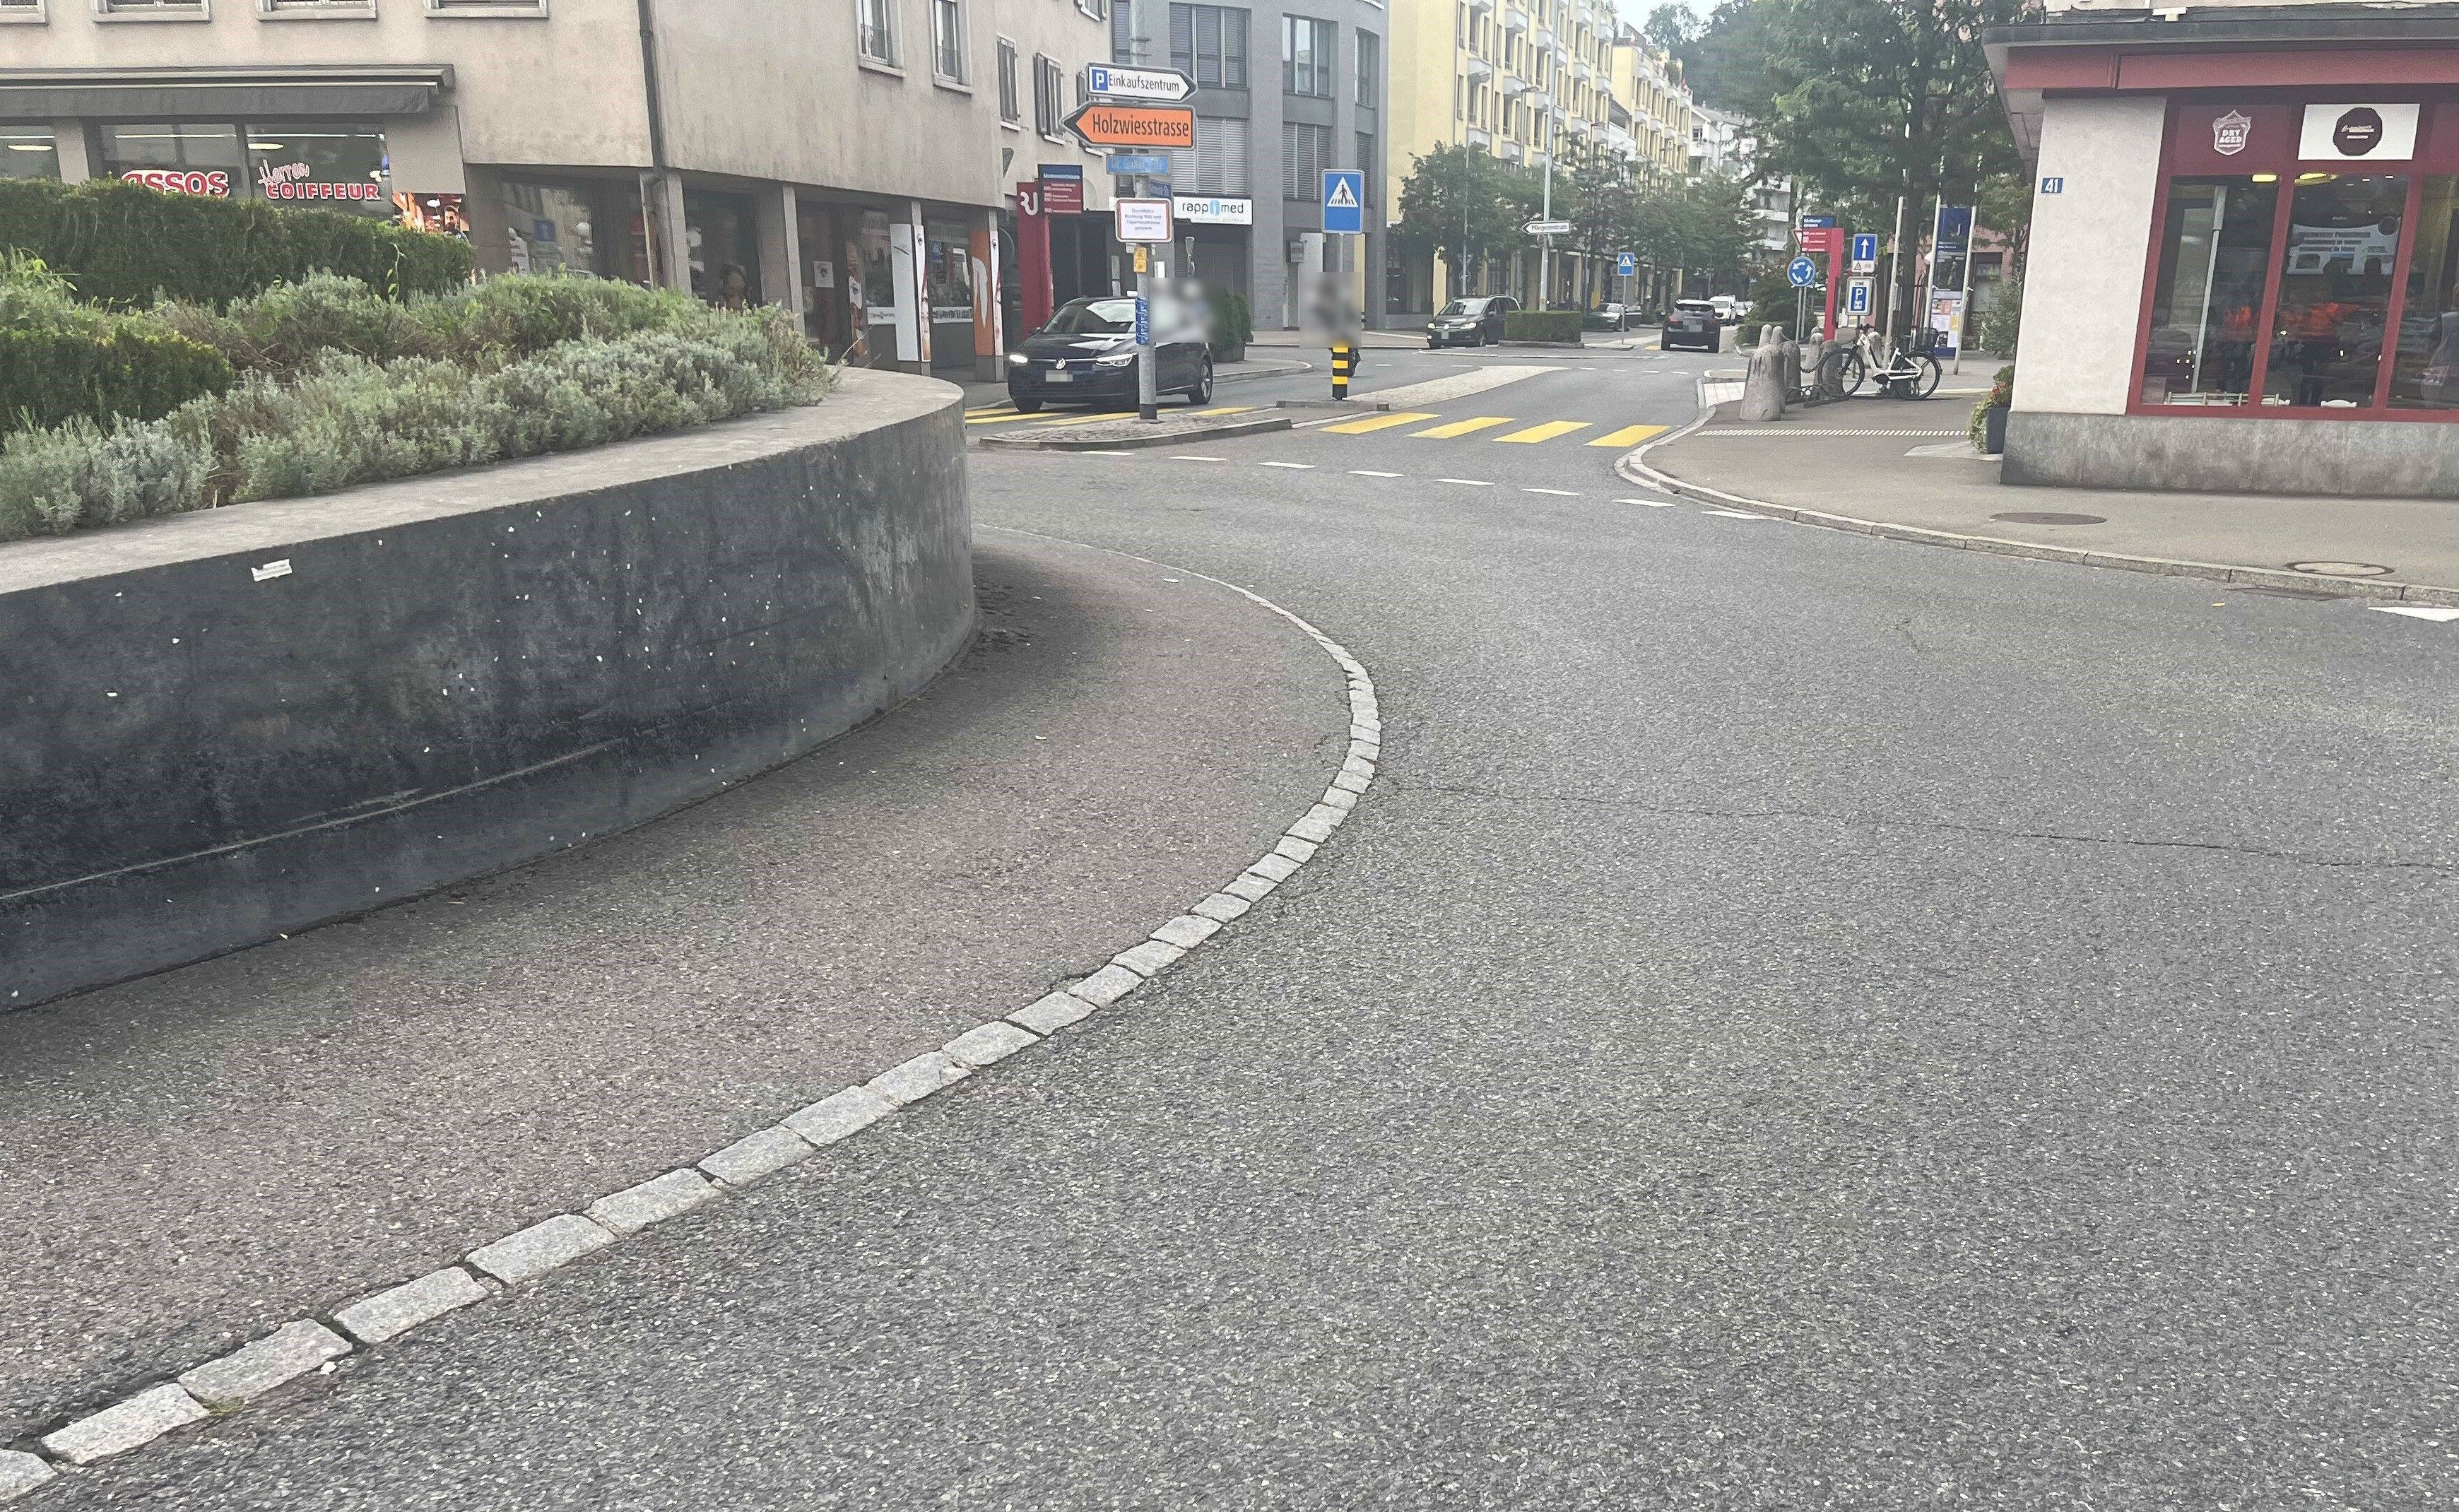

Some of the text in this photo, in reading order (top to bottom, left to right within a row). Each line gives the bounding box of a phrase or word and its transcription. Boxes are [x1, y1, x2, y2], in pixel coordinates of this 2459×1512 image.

[1095, 71, 1179, 92] P Einkaufszentrum
[1092, 112, 1189, 137] Holzwiesstrasse
[265, 182, 382, 201] COIFFEUR
[2044, 178, 2059, 193] 41
[1855, 288, 1863, 301] P
